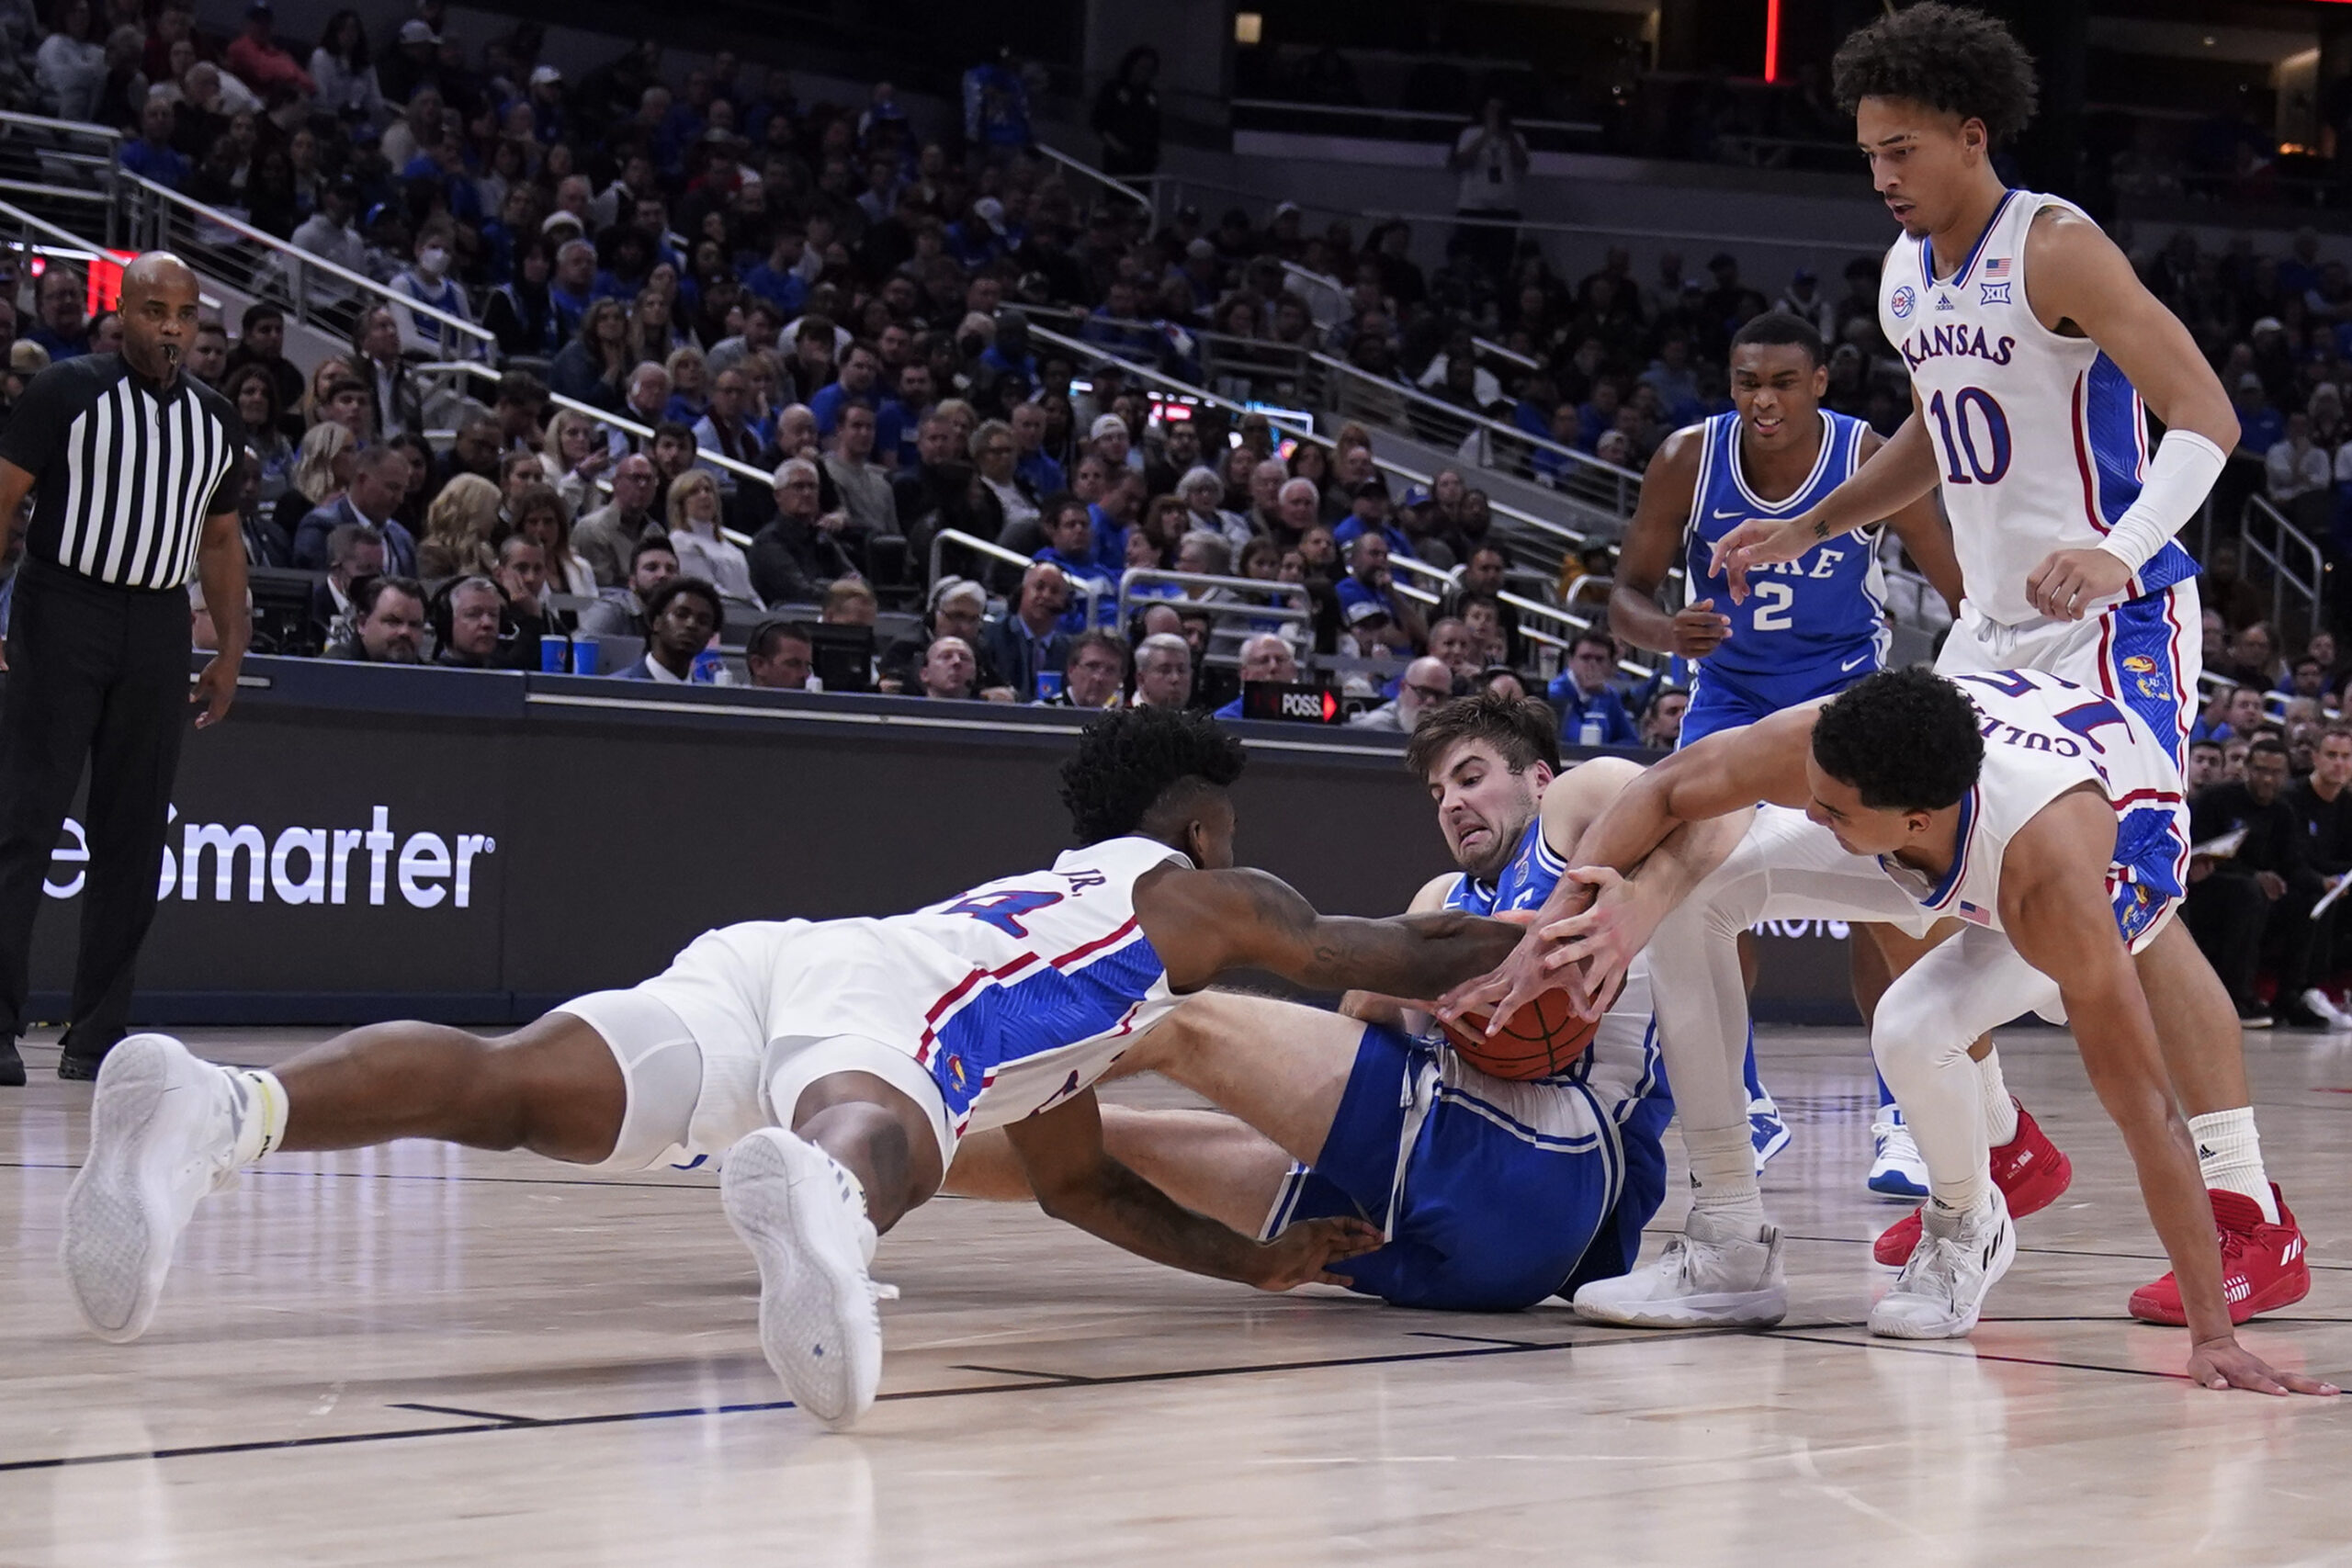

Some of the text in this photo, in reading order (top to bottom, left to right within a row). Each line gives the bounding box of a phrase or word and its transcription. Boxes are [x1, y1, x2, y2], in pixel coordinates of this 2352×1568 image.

[1901, 323, 2016, 373] KANSAS
[1930, 387, 2012, 485] 10
[1754, 581, 1793, 631] 2
